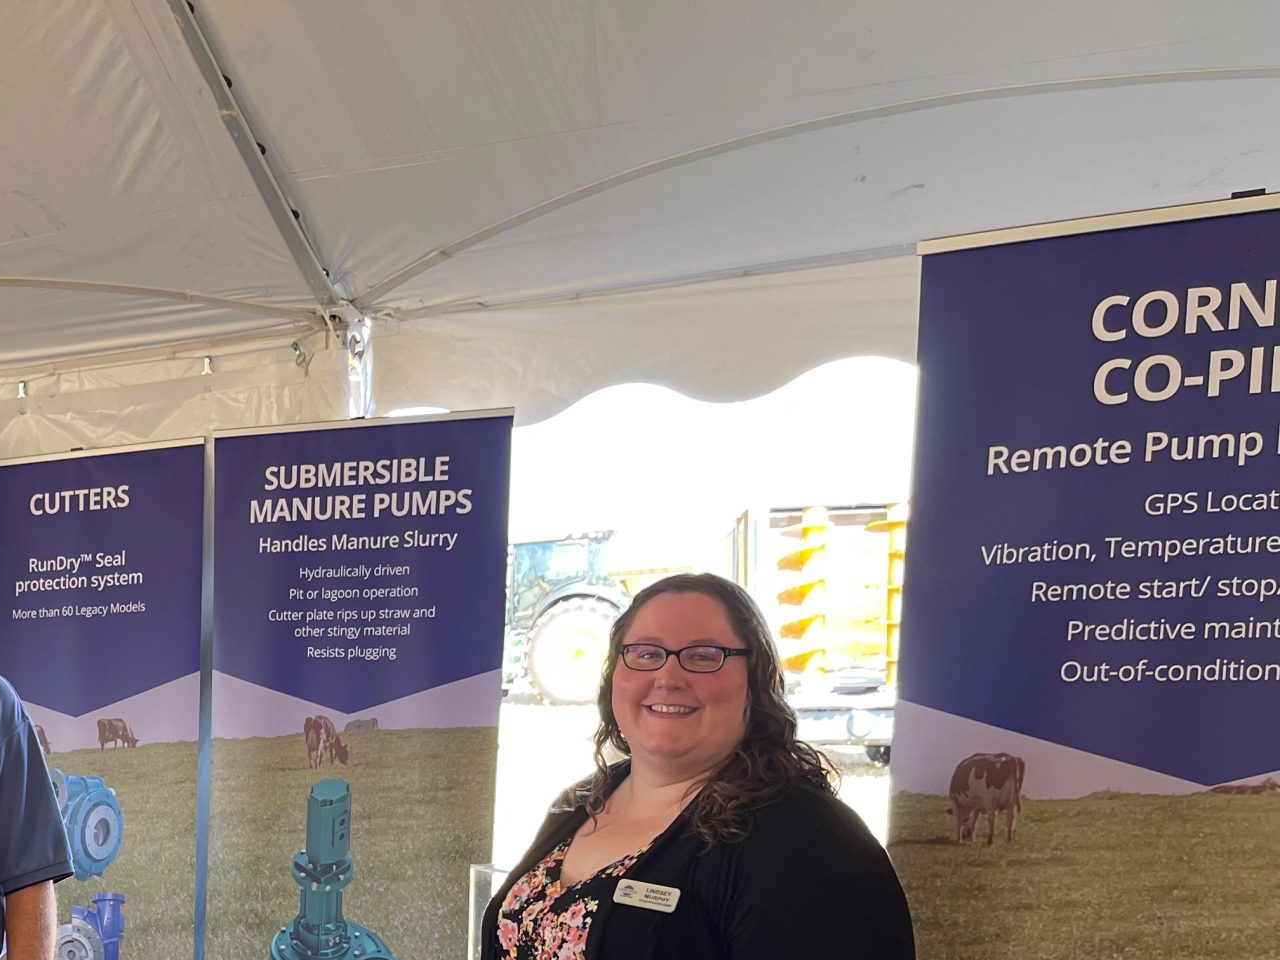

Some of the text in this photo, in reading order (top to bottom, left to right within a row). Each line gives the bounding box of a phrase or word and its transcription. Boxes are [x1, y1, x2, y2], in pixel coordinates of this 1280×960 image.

[1091, 279, 1277, 342] CORN
[986, 437, 1132, 475] Remote
[1144, 431, 1263, 466] Pump
[264, 455, 450, 491] SUBMERSIBLE
[29, 485, 130, 516] CUTTERS
[249, 488, 473, 524] MANURE PUMPS
[1144, 489, 1280, 515] GPS Locat
[259, 530, 458, 554] Handles Manure Slurry
[981, 534, 1280, 565] Vibration, Temperature
[95, 550, 126, 568] Seal
[15, 571, 143, 596] protection system
[299, 564, 410, 582] Hydraulically driven
[289, 585, 419, 603] Pit or lagoon operation
[1031, 575, 1280, 602] Remote start/ stop
[12, 601, 146, 620] More than 60 Legacy Models
[268, 606, 436, 623] Cutter plate rips up straw and
[294, 623, 411, 640] other stingy material
[1067, 616, 1280, 641] Predictive maint
[306, 645, 397, 660] Resists plugging
[1060, 659, 1280, 682] Out-of-condition
